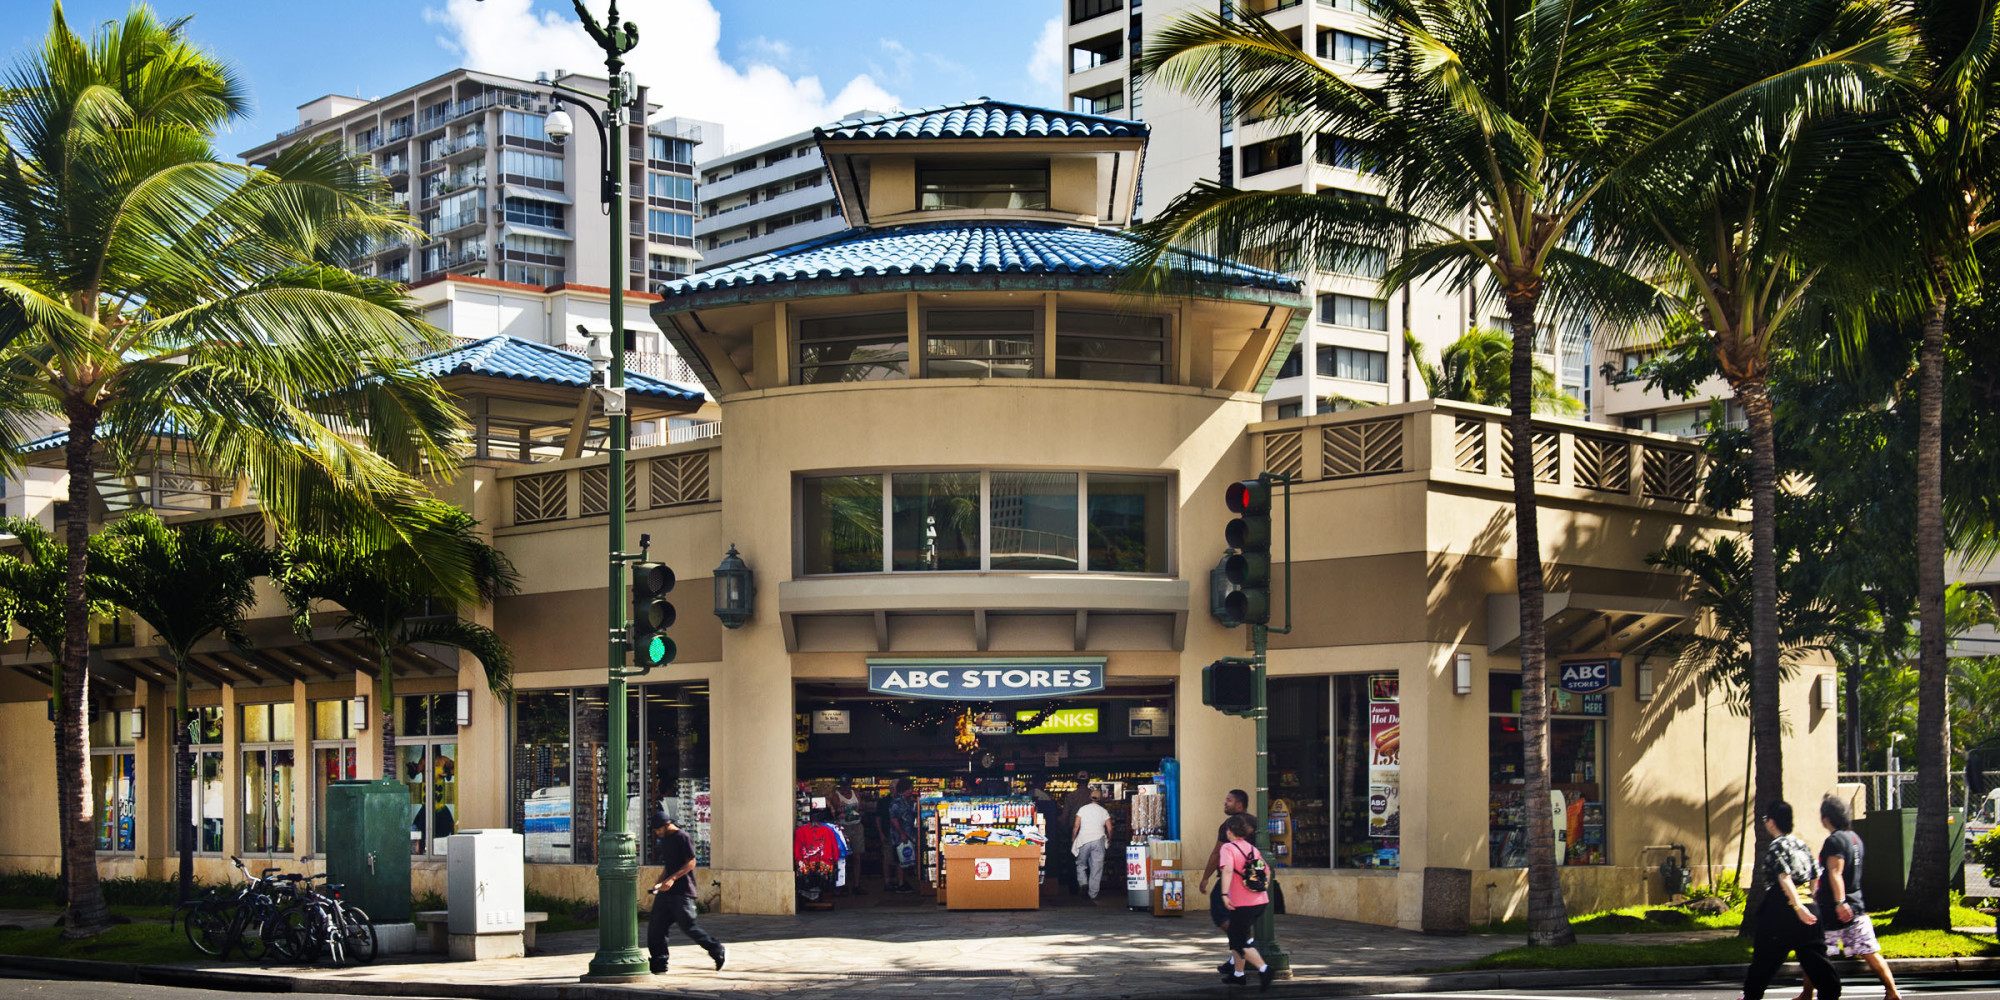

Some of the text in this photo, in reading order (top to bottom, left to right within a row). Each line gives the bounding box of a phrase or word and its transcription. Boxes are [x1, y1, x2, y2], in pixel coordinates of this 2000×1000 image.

[1562, 665, 1606, 680] ABC
[881, 669, 1092, 689] ABC STORES
[1568, 680, 1600, 688] STORES
[1584, 702, 1603, 713] HERE
[1372, 714, 1400, 723] Hot Do
